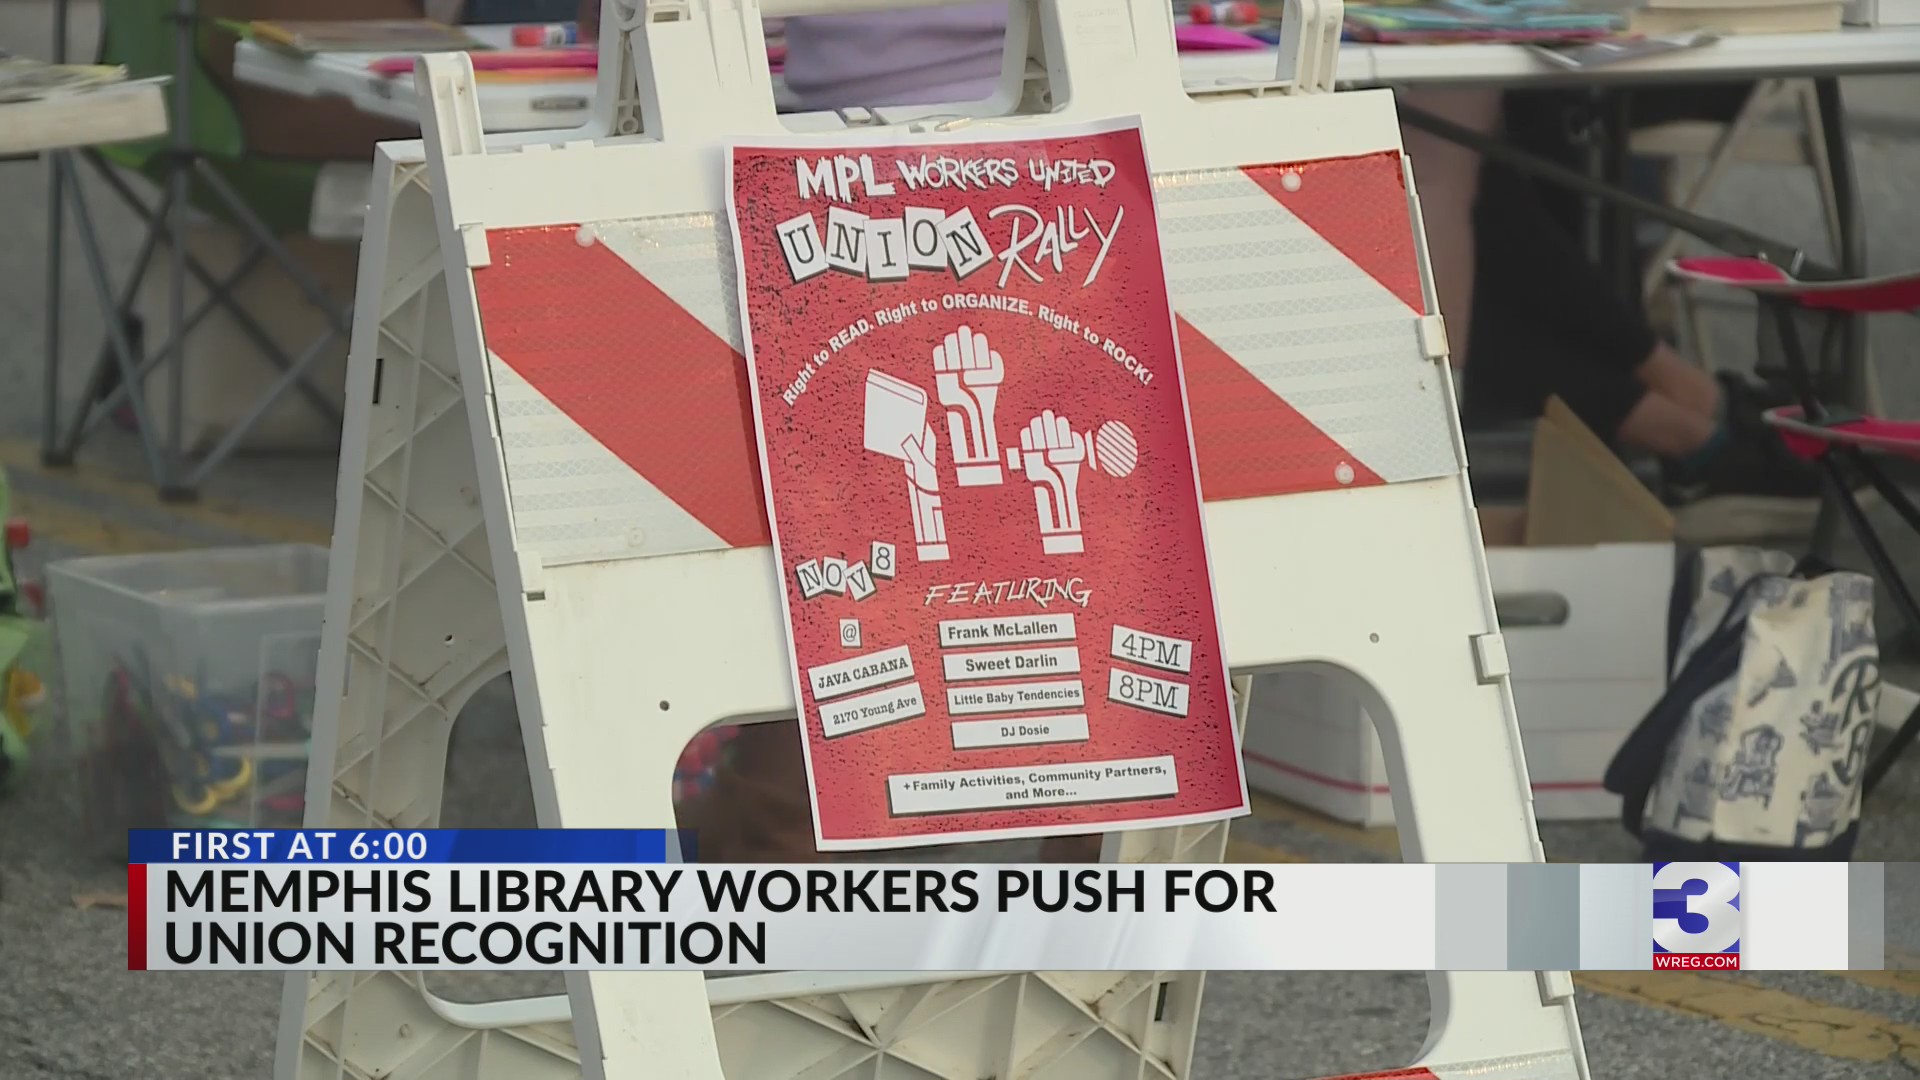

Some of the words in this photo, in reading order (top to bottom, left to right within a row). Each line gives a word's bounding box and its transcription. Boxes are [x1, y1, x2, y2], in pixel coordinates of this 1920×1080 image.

[796, 154, 896, 201] MPL
[897, 155, 1019, 192] WORKERS
[1029, 158, 1116, 191] UNITED
[782, 217, 984, 269] UNION
[782, 362, 816, 407] Right
[813, 349, 830, 367] to
[828, 318, 875, 353] READ.
[875, 300, 918, 326] Right
[921, 298, 938, 313] to
[942, 293, 1033, 316] ORGANIZE.
[1038, 304, 1080, 335] Right
[1083, 326, 1100, 345] to
[1102, 338, 1153, 386] ROCK!
[798, 562, 867, 593] NOV
[875, 546, 891, 571] 8
[924, 576, 1093, 608] FEATURING
[842, 623, 857, 642] @
[948, 625, 989, 640] Frank
[993, 621, 1058, 637] McLallen
[965, 656, 1011, 672] Sweet
[1015, 653, 1058, 669] Darlin
[1121, 633, 1182, 667] 4PM
[818, 671, 852, 689] JAVA
[852, 657, 908, 680] CABANA
[954, 693, 984, 705] Little
[986, 692, 1014, 705] Baby
[1017, 687, 1080, 702] Tendencies
[1119, 674, 1179, 710] 8PM
[832, 710, 859, 725] 2170
[860, 701, 895, 718] Young
[896, 697, 917, 709] Ave
[1001, 726, 1015, 737] DJ
[1019, 724, 1050, 736] Dosie
[959, 773, 1026, 788] Activities,
[1028, 770, 1101, 784] Community
[1105, 765, 1167, 778] Partners,
[1005, 788, 1029, 800] and
[1033, 787, 1077, 799] More...
